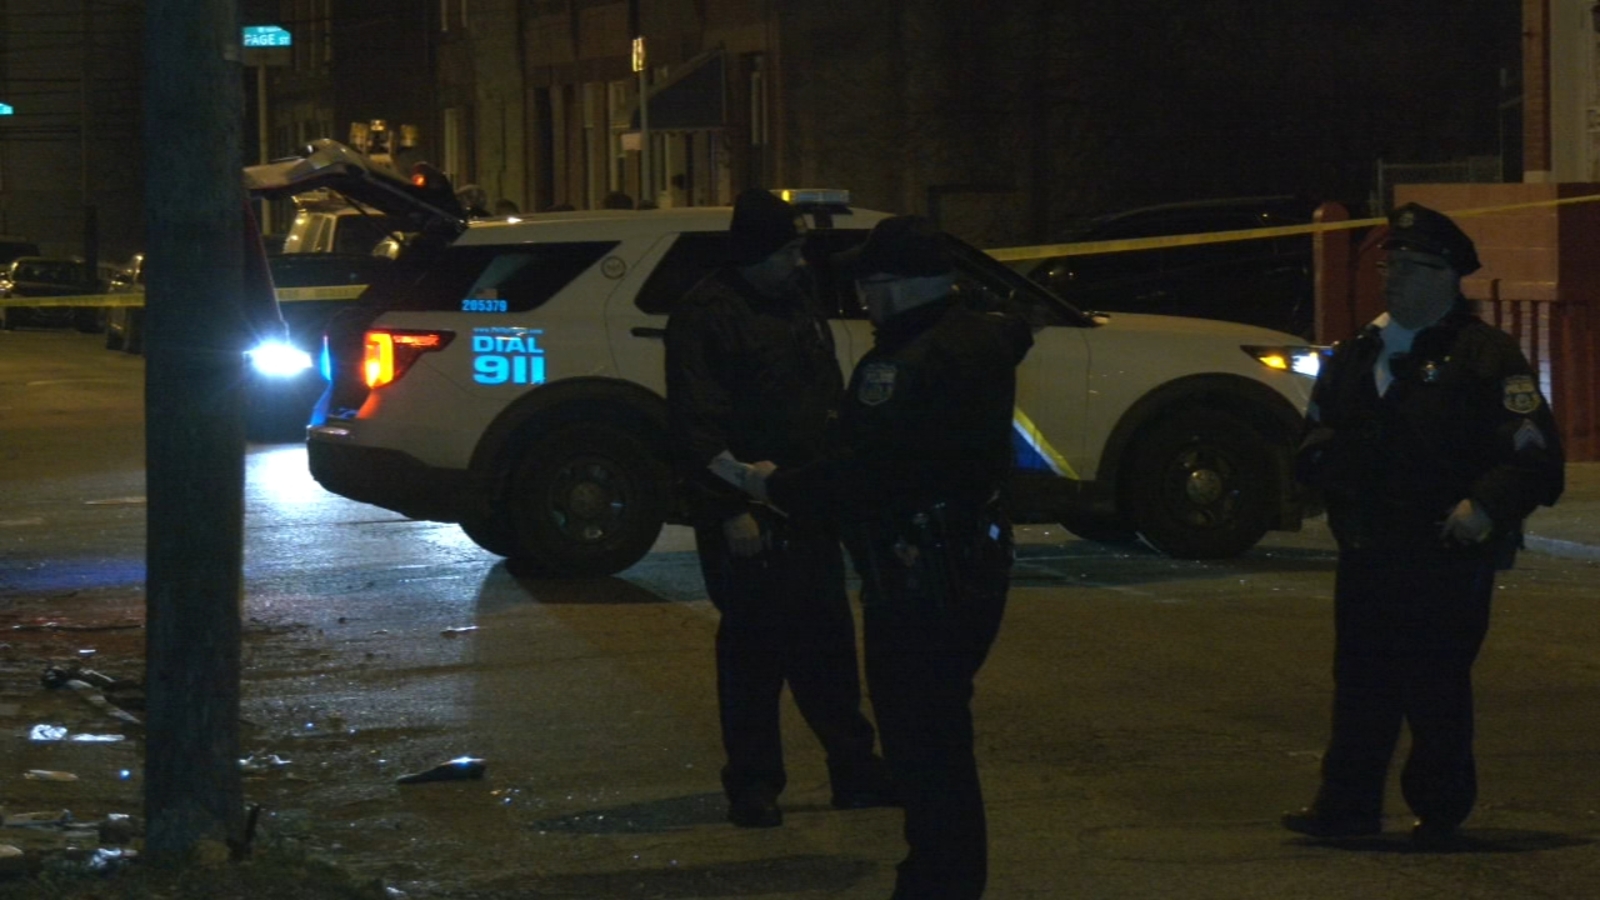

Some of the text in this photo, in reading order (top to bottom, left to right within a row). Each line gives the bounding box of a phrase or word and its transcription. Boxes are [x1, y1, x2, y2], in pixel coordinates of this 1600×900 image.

[244, 34, 275, 46] PAGE
[473, 336, 544, 353] DIAL
[473, 355, 545, 385] 911
